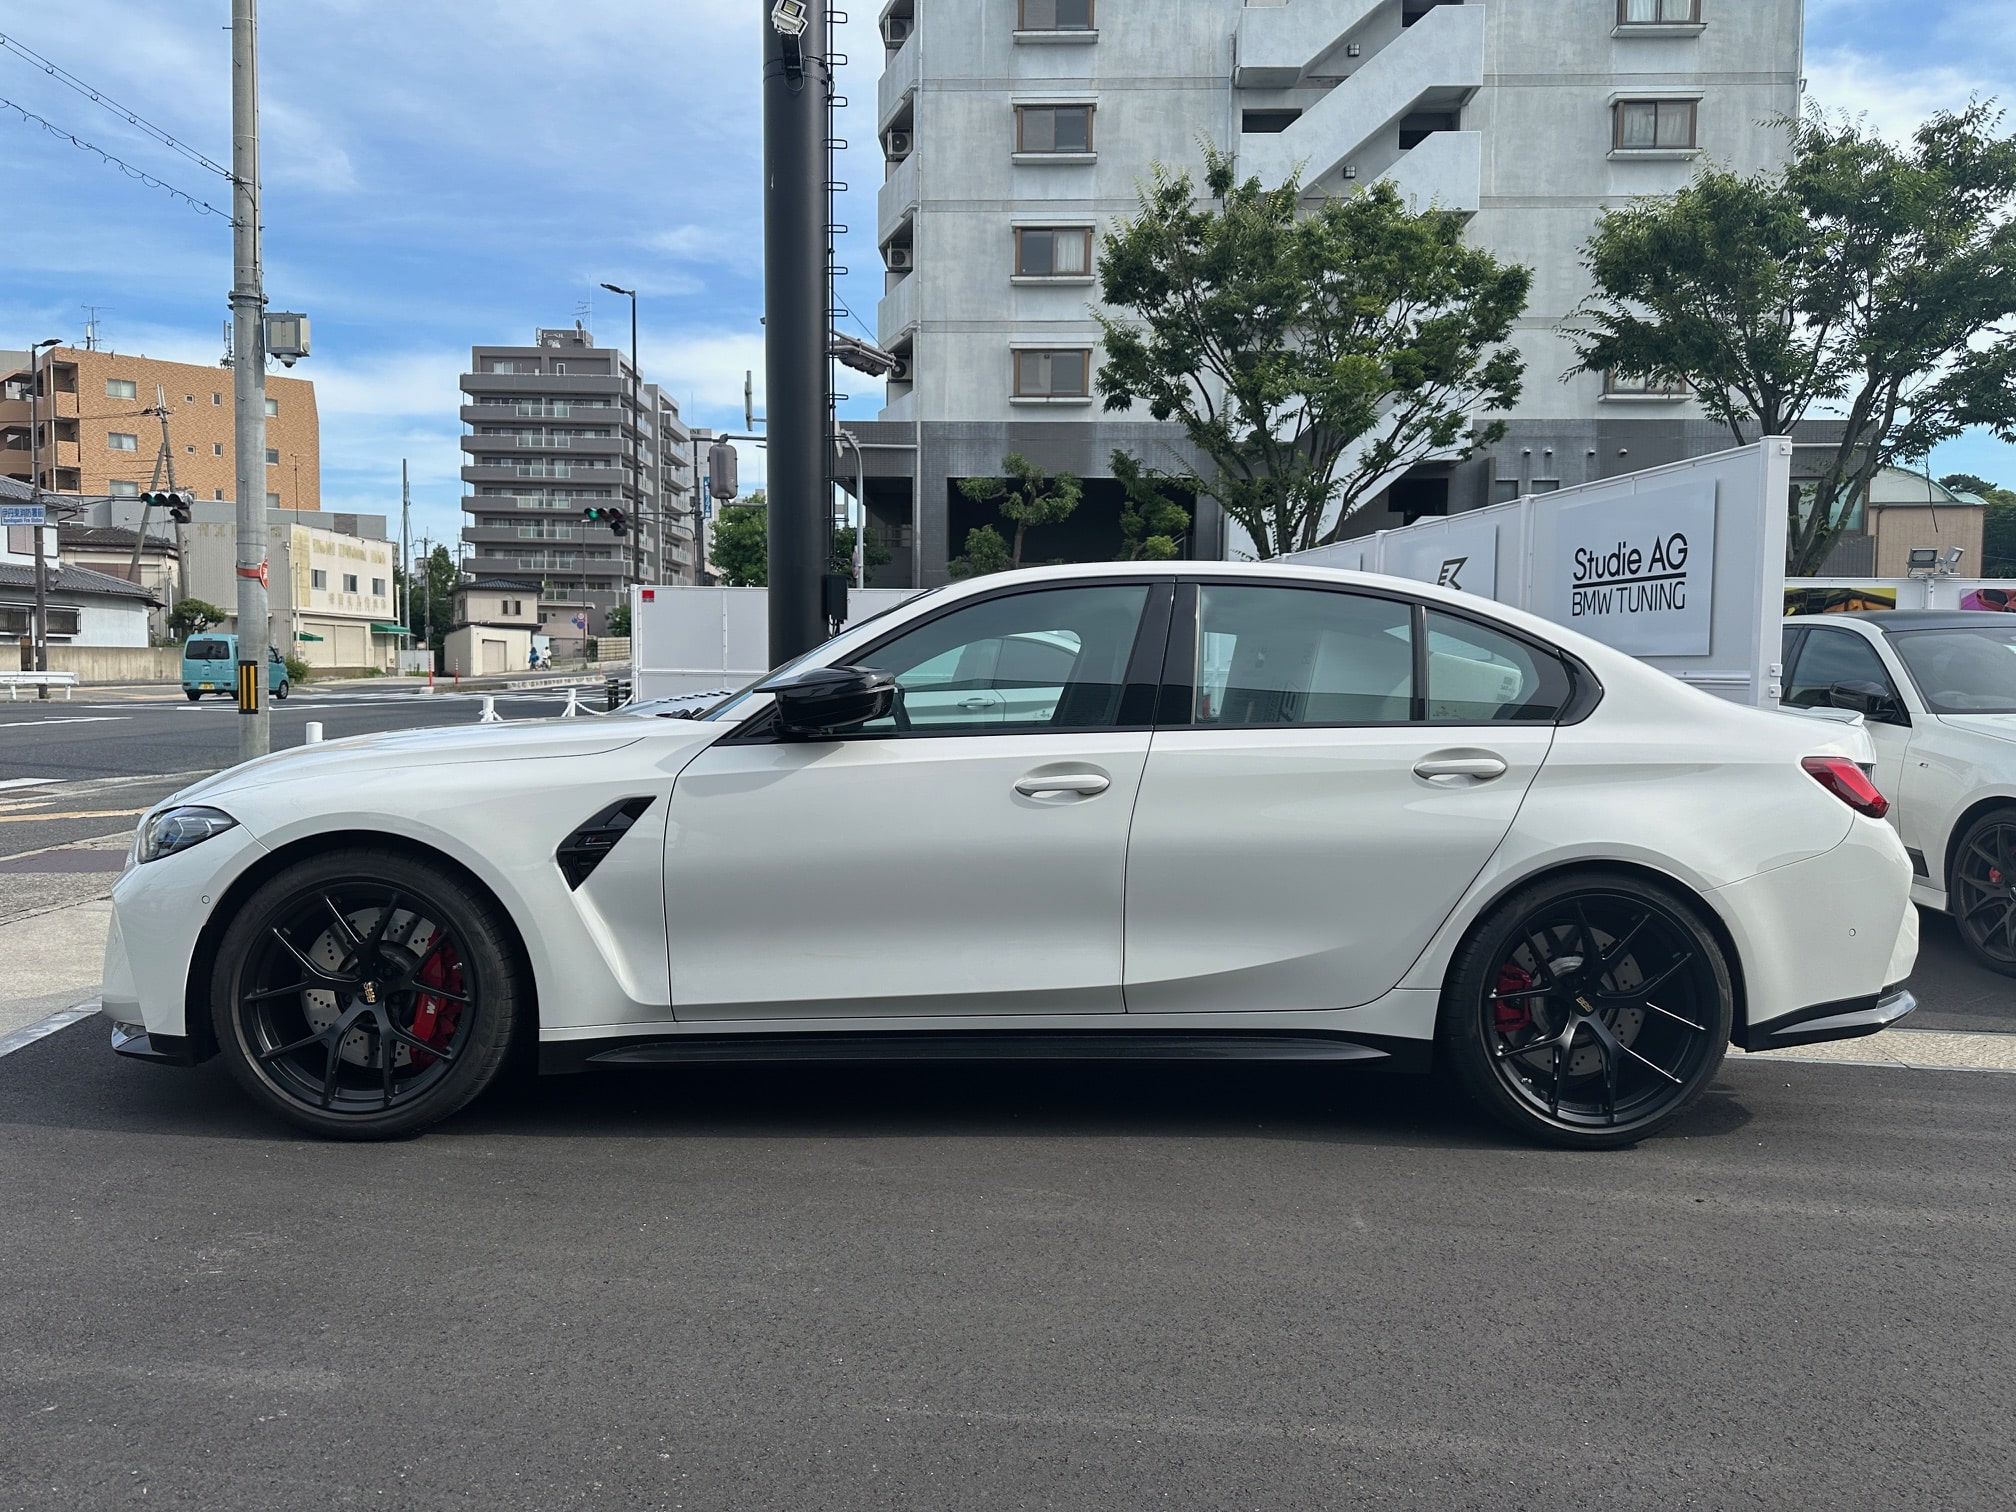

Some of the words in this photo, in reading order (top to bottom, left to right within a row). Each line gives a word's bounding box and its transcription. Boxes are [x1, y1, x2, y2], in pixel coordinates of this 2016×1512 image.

[1573, 541, 1642, 581] Studie
[1648, 532, 1688, 572] AG
[1572, 589, 1613, 616] BMW
[1616, 581, 1686, 613] TUNING
